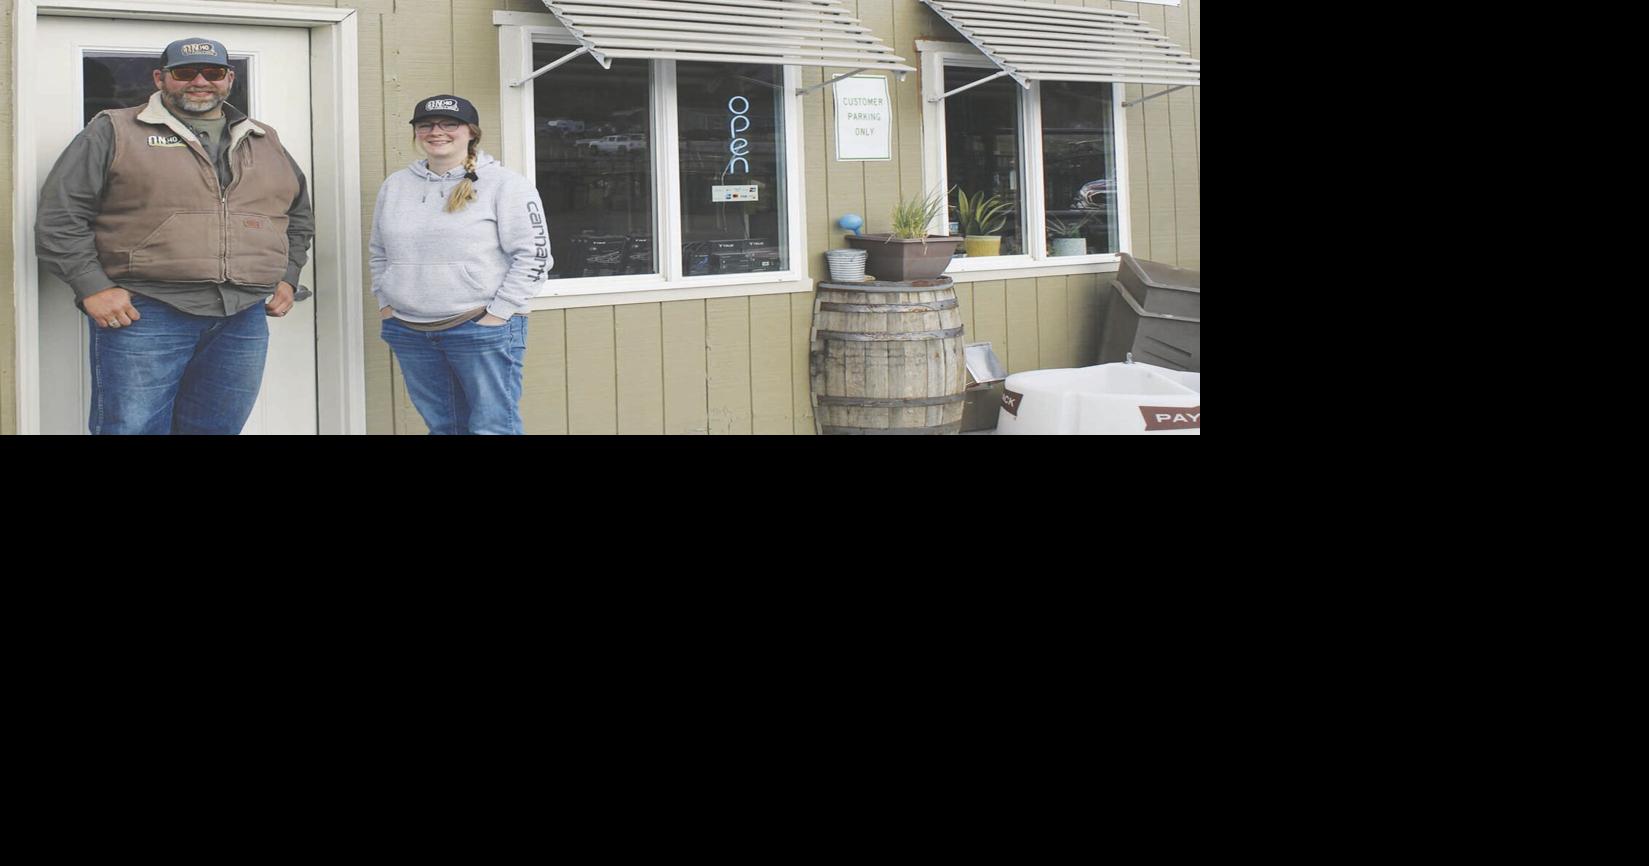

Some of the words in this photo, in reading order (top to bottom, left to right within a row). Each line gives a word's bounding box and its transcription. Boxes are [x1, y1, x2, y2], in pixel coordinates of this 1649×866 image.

[843, 97, 884, 106] CUSTOMER
[848, 112, 881, 121] PARKING
[855, 127, 875, 136] ONLY
[1155, 413, 1200, 423] PAY
